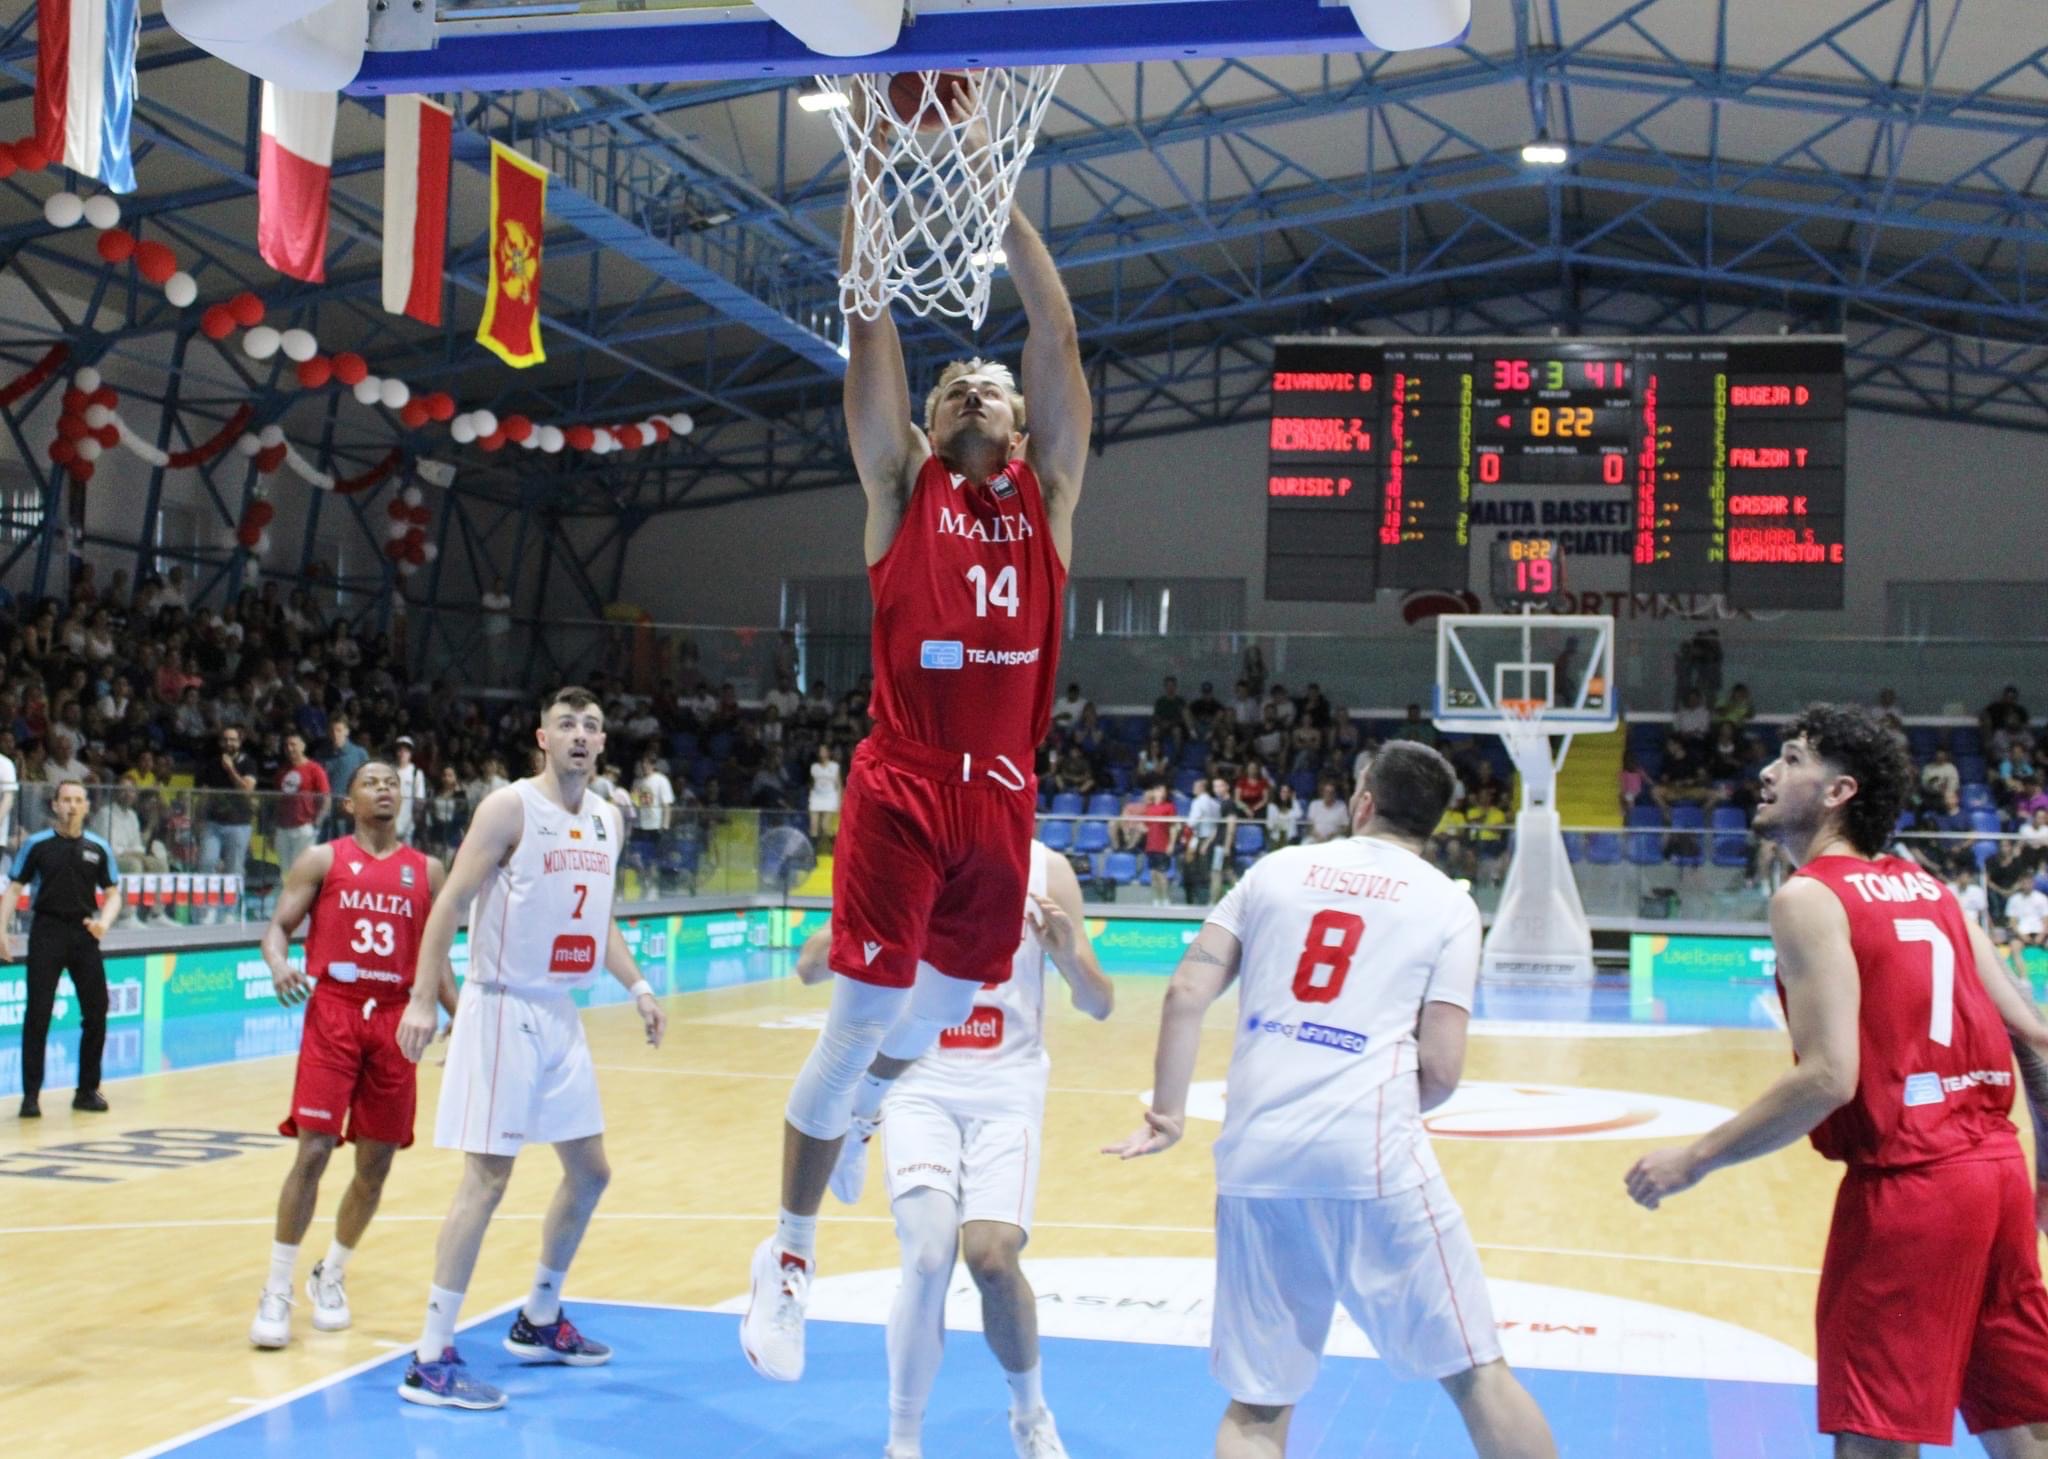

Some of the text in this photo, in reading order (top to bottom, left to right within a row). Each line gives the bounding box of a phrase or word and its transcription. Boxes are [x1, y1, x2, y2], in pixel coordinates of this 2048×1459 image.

[1494, 360, 1531, 390] 36
[1547, 361, 1564, 389] 3
[1584, 361, 1625, 389] 41
[1730, 385, 1809, 406] BUGEJA D
[1531, 407, 1595, 437] 8 22
[1480, 452, 1500, 483] 0
[1603, 452, 1624, 483] 0
[1338, 477, 1352, 496] P
[937, 505, 1034, 543] MALTA
[1541, 500, 1630, 524] BASKET
[1510, 540, 1551, 561] 8:22
[965, 563, 1020, 618] 14
[1515, 559, 1553, 593] 19
[543, 848, 611, 876] MONTENEGRO
[1303, 863, 1409, 902] KUSOVAC
[1844, 871, 1943, 903] TOMAS
[339, 889, 414, 918] MALTA
[571, 884, 588, 920] 7
[350, 917, 396, 957] 33
[1291, 908, 1366, 1004] 8
[1892, 917, 1956, 1048] 7
